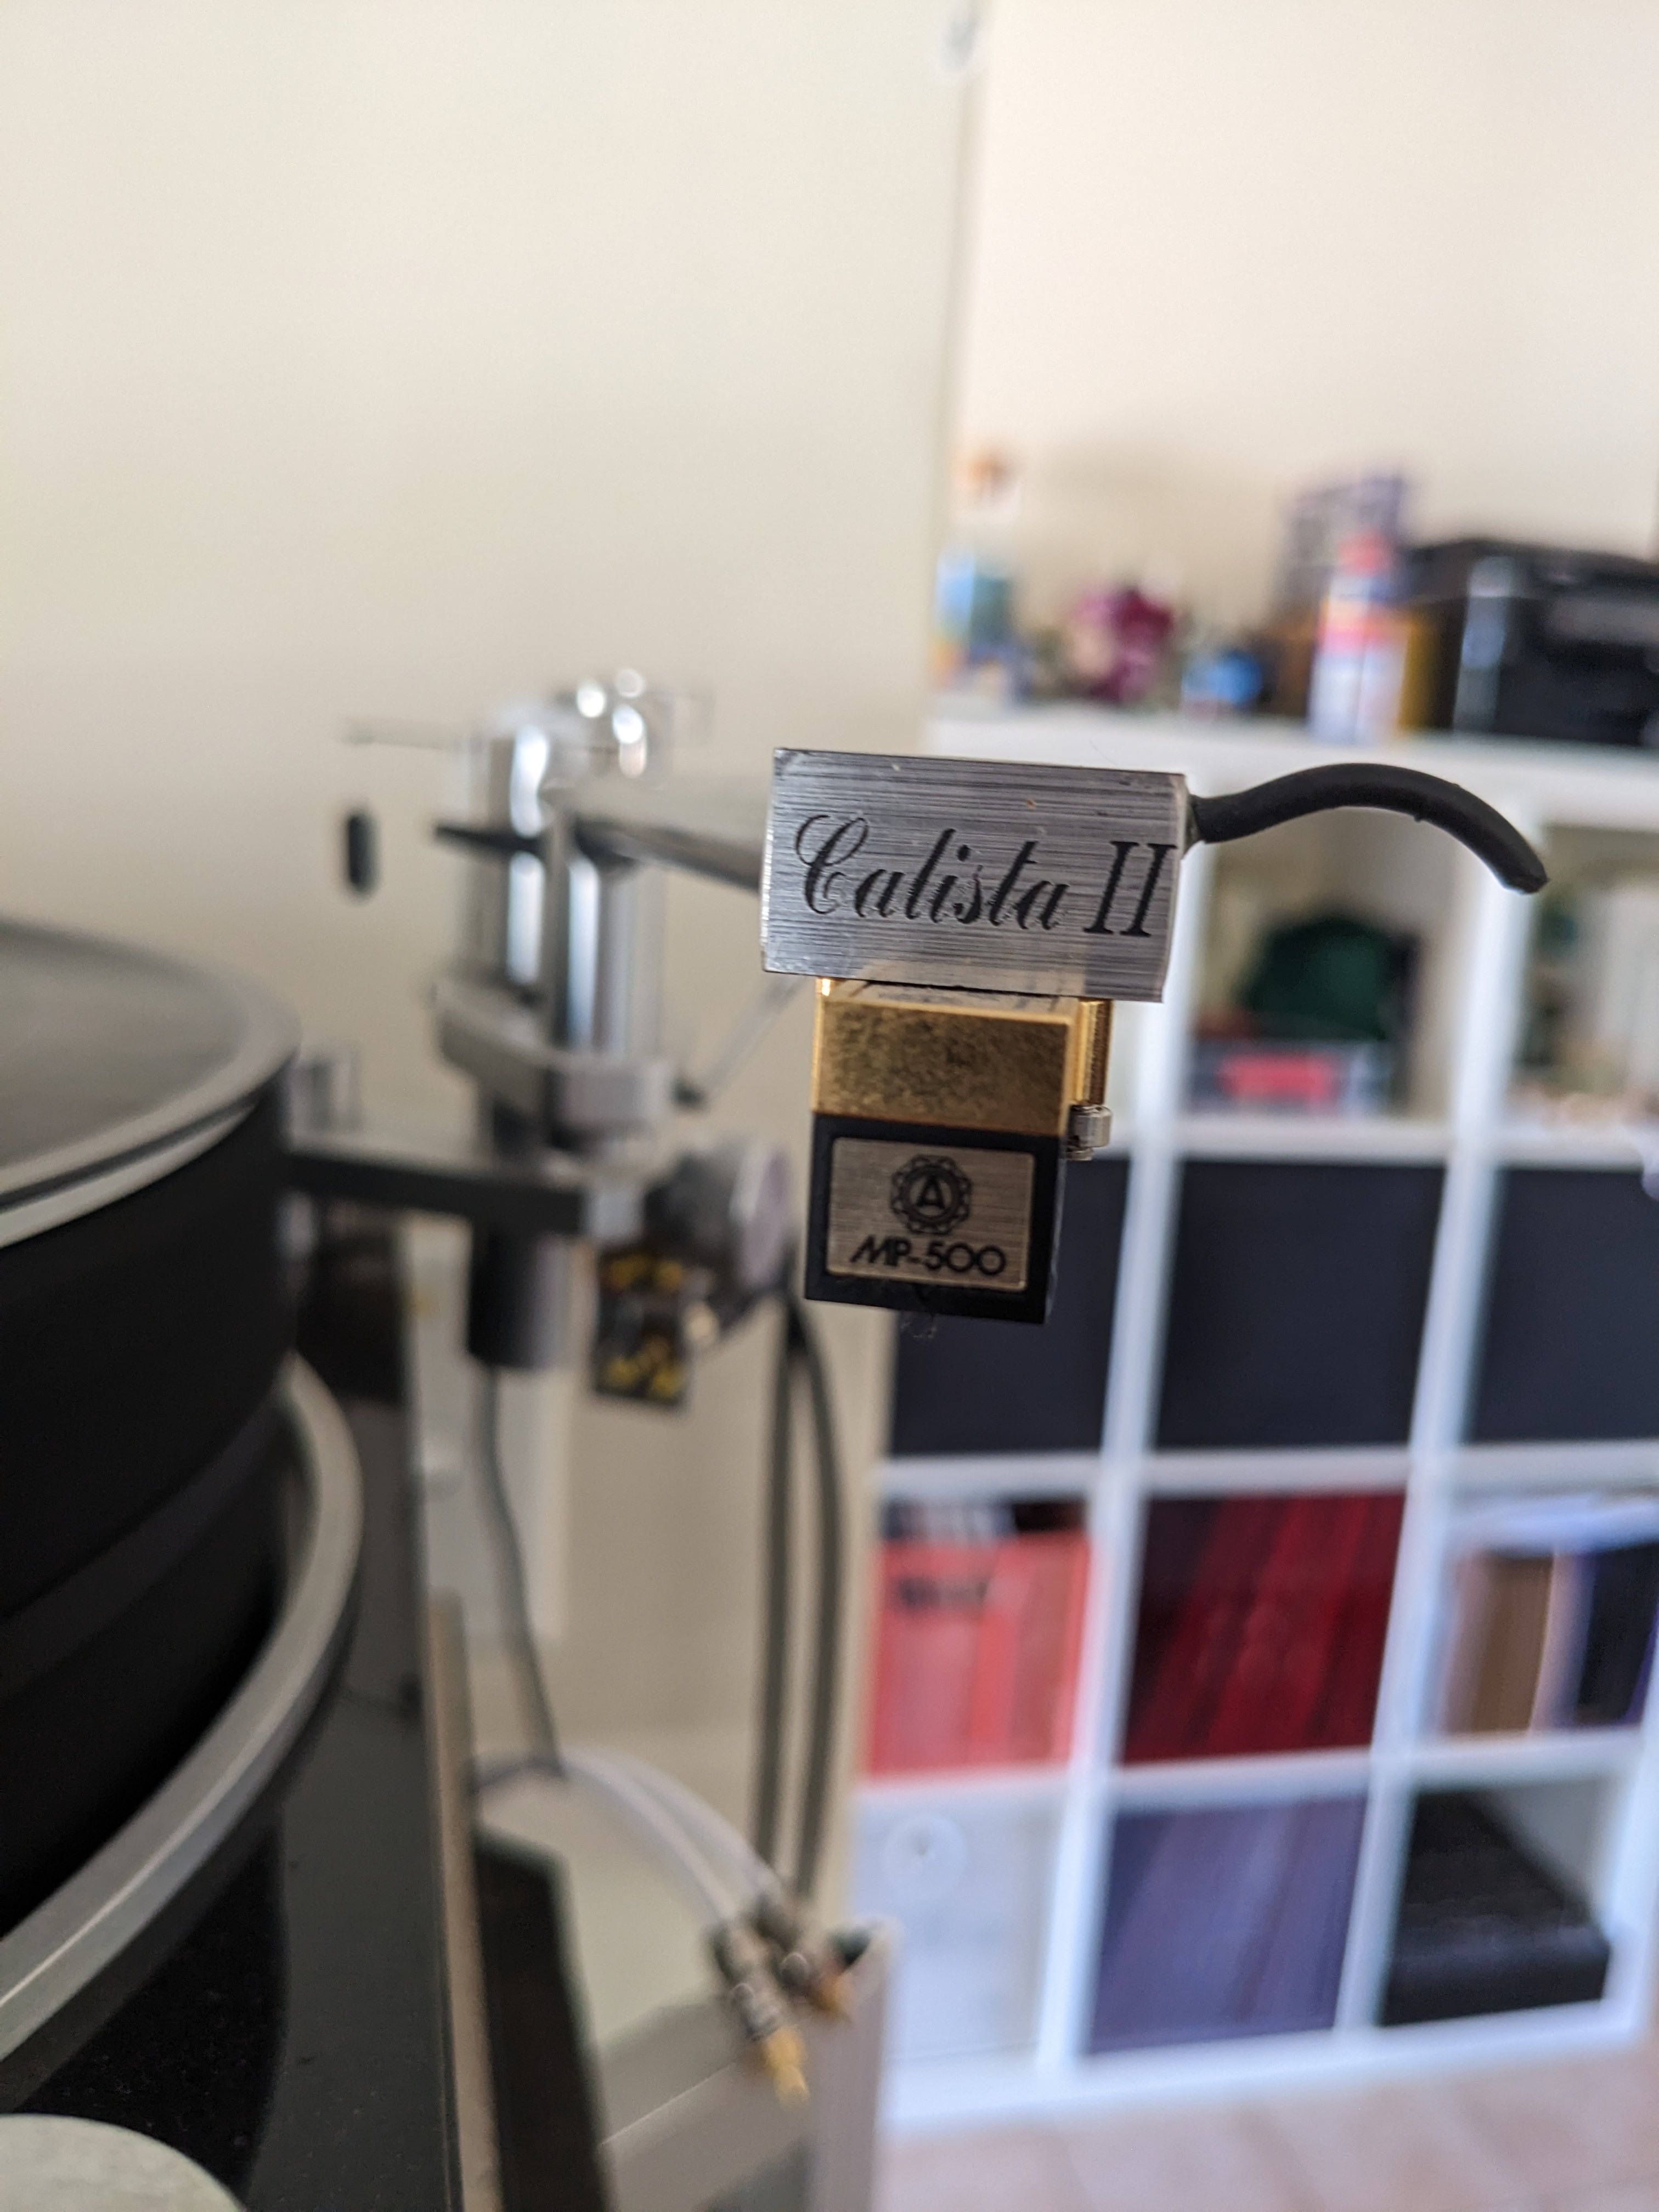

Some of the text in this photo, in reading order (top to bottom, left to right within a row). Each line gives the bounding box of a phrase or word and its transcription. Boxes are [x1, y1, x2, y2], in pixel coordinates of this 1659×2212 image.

[795, 814, 1177, 938] Calista II
[850, 1234, 1007, 1276] MP-500
